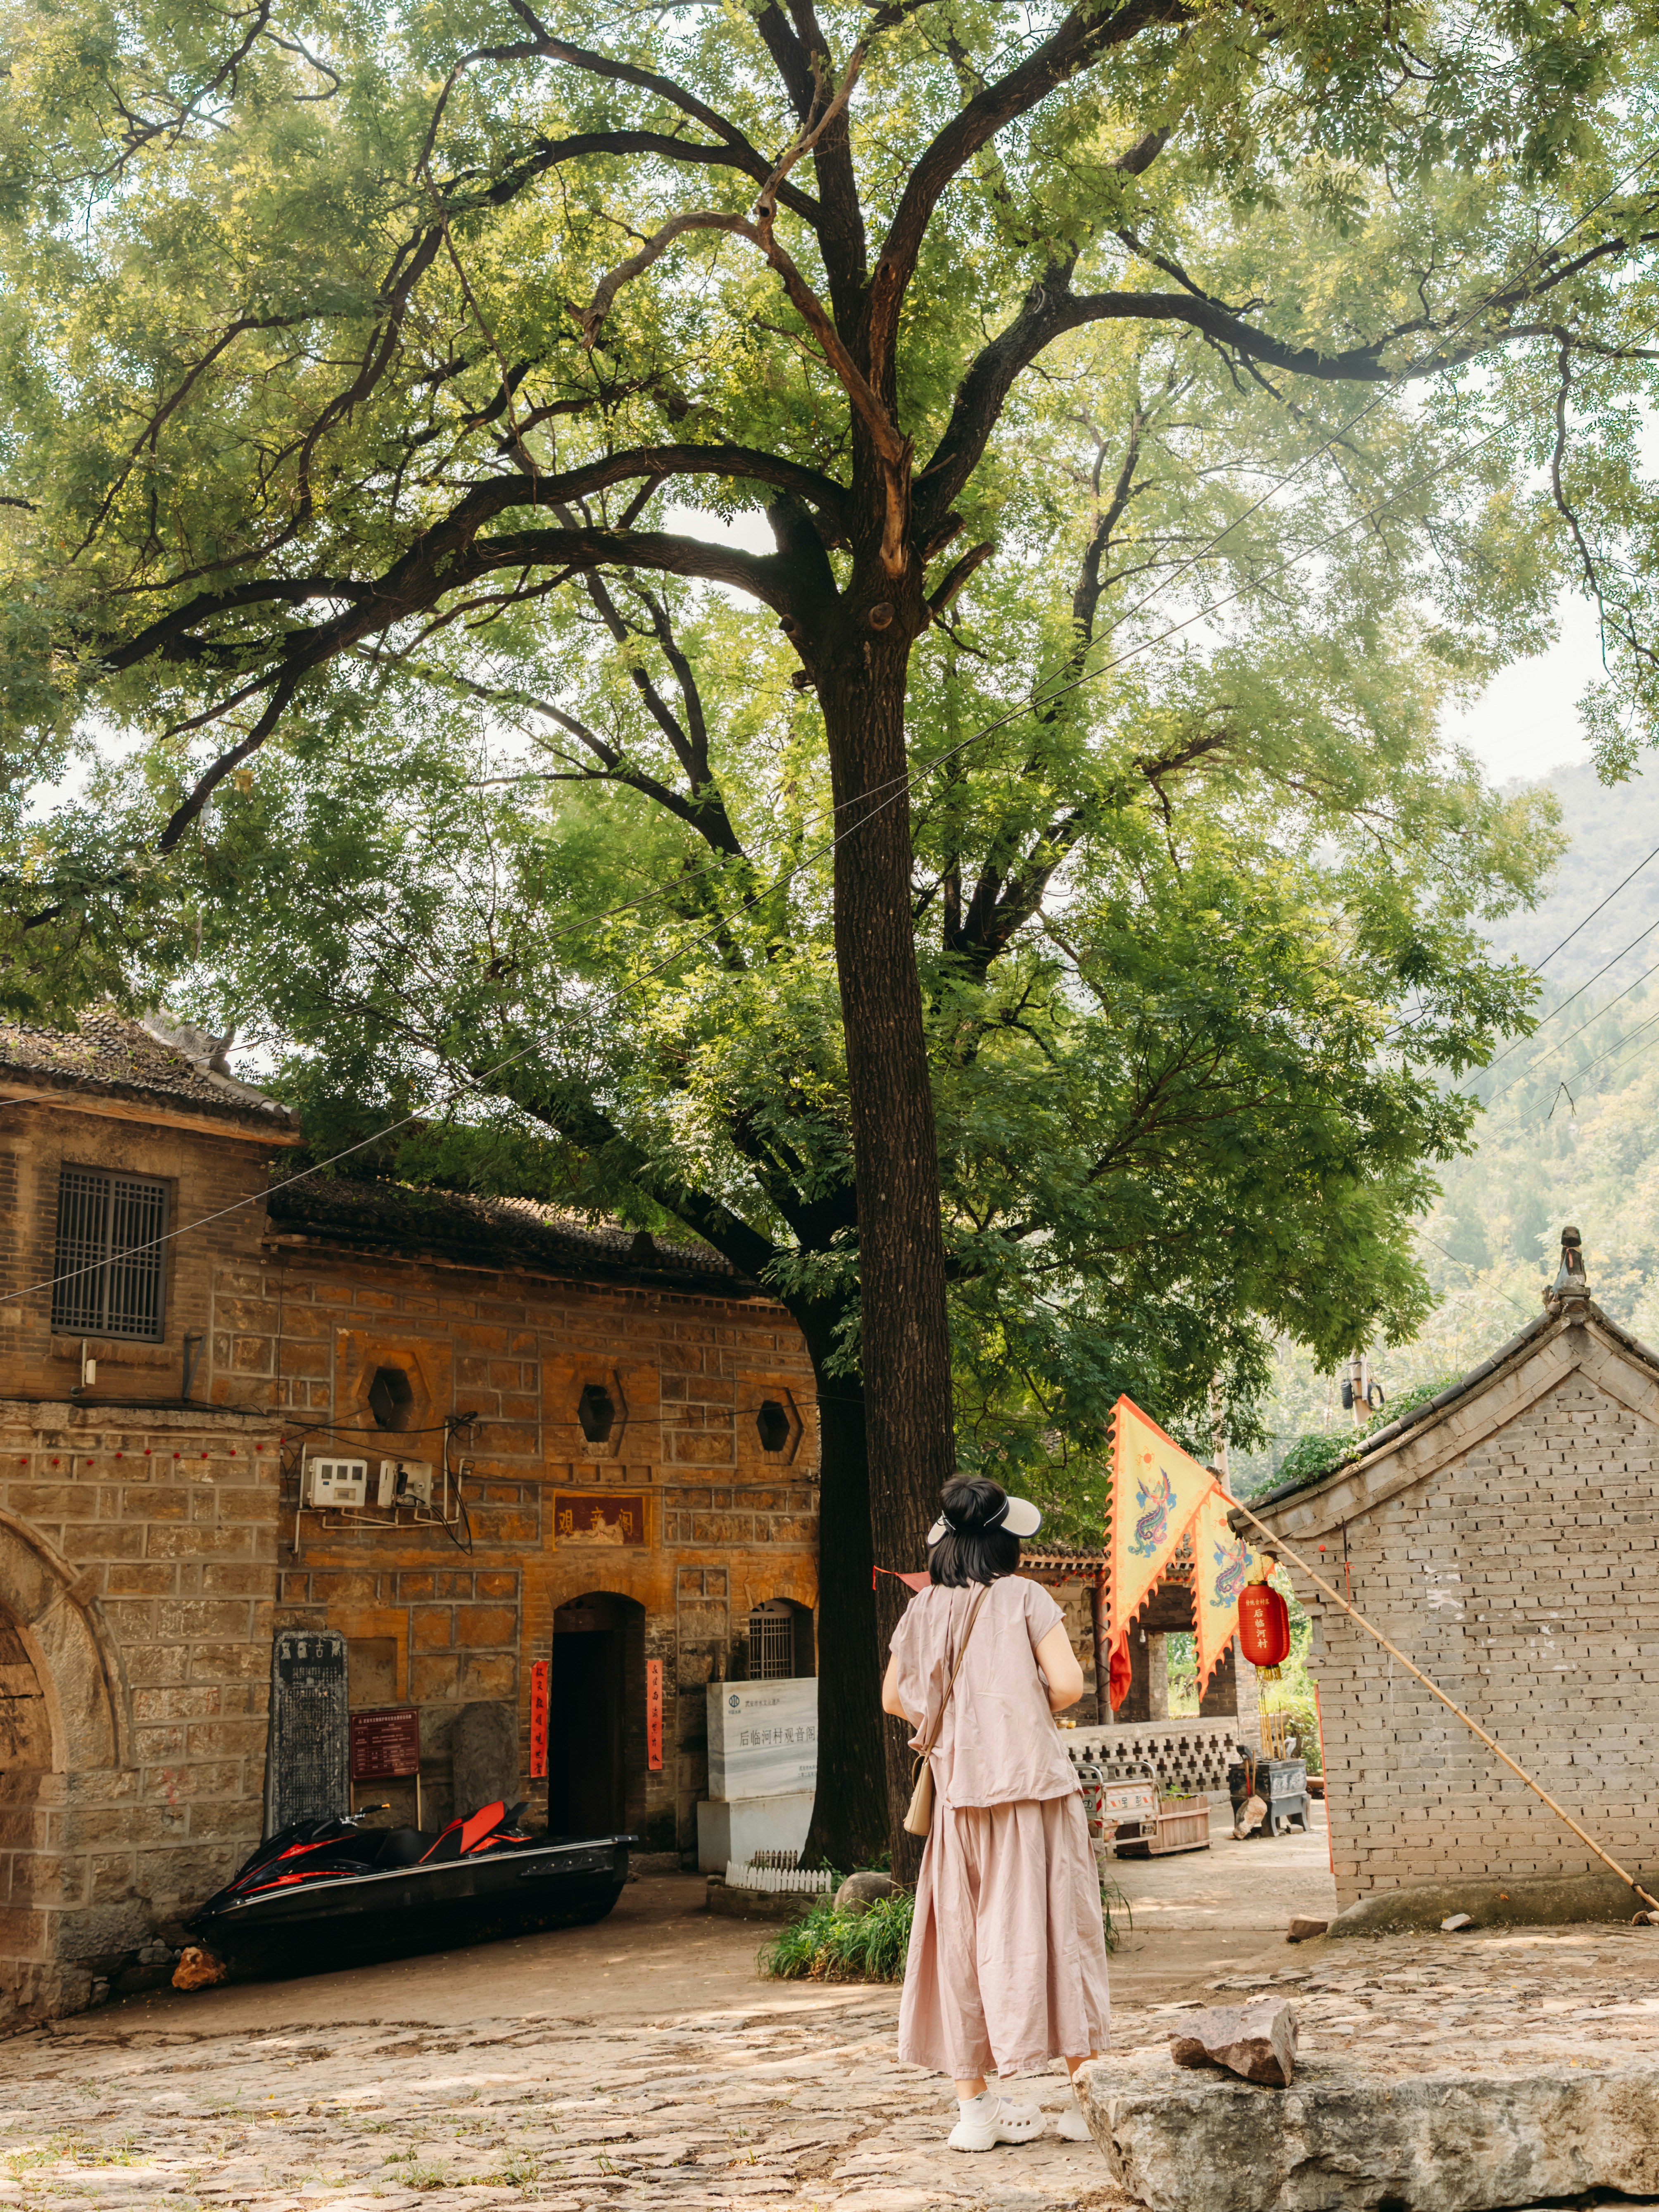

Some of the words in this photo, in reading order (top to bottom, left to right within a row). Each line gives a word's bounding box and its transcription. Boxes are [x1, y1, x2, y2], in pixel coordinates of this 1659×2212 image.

[1253, 1609, 1268, 1649] 后临河村
[745, 1698, 780, 1707] 武安市水文化遗产
[739, 1726, 815, 1747] 后临河村观音阁
